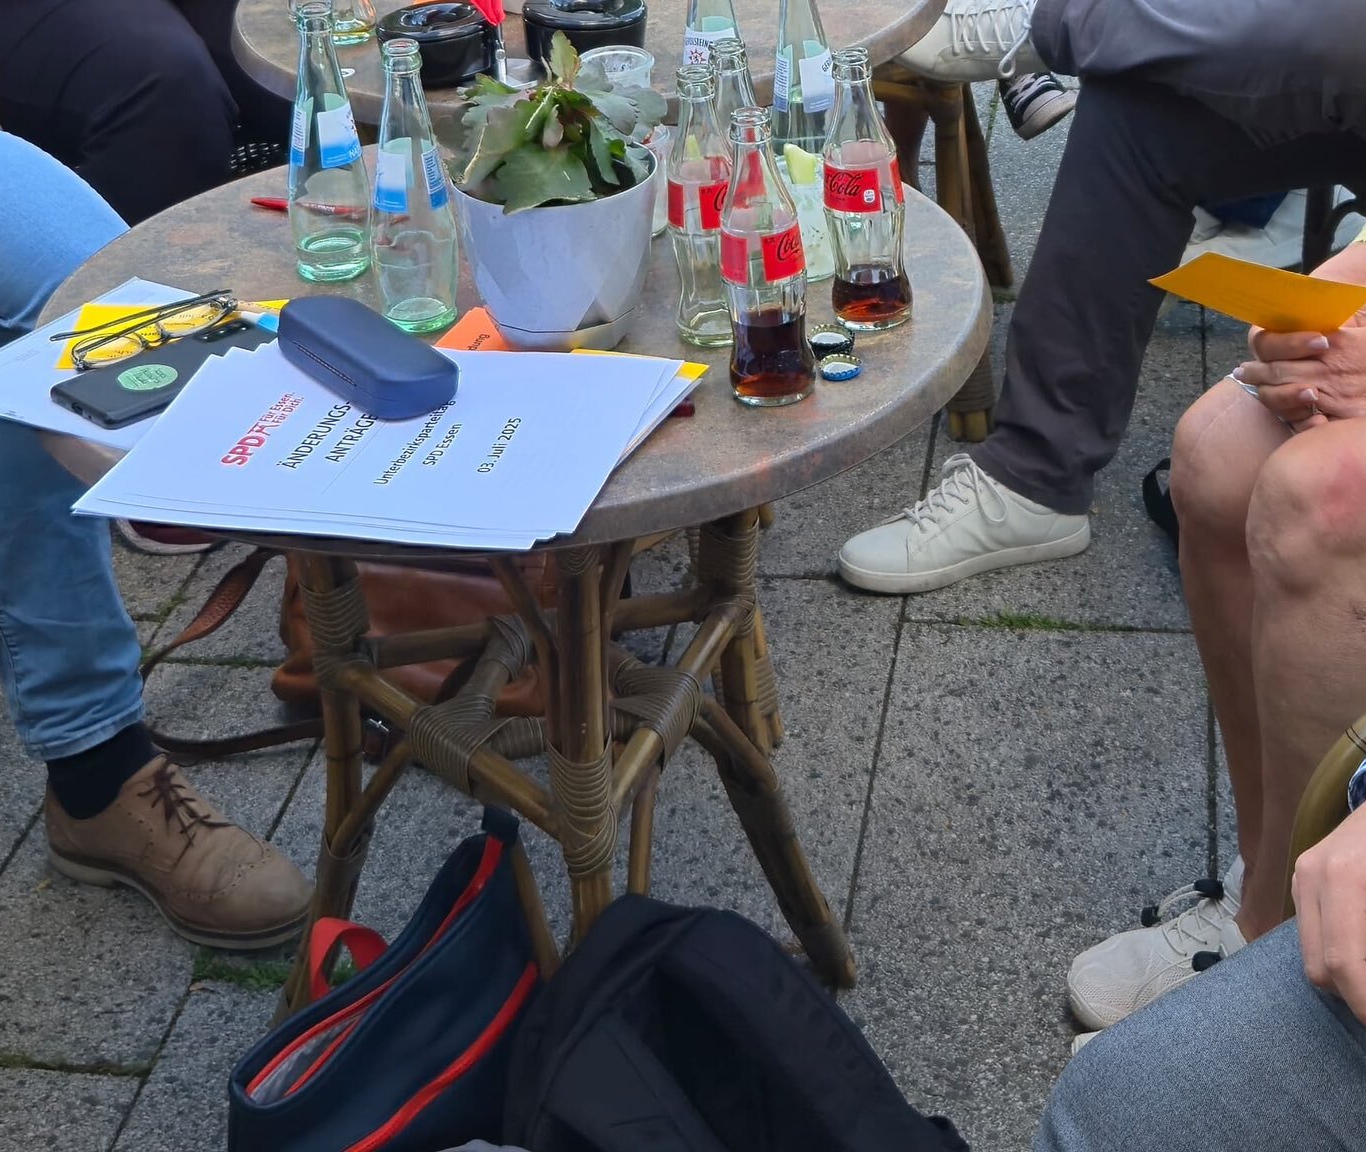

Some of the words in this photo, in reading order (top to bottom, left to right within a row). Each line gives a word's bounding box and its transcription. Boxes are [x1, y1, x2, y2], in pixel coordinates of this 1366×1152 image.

[260, 407, 275, 422] Für
[272, 392, 295, 411] Essen.
[272, 411, 288, 427] Für
[283, 397, 305, 414] Dich.
[276, 400, 353, 469] ÄNDERUNGS-
[325, 413, 379, 463] ANTRÄGE
[373, 399, 457, 485] Unterbezirksparteitag
[422, 449, 445, 466] SPD
[436, 422, 463, 450] Essen
[497, 416, 523, 441] 2025
[221, 435, 267, 466] SPD
[488, 442, 509, 459] Juli
